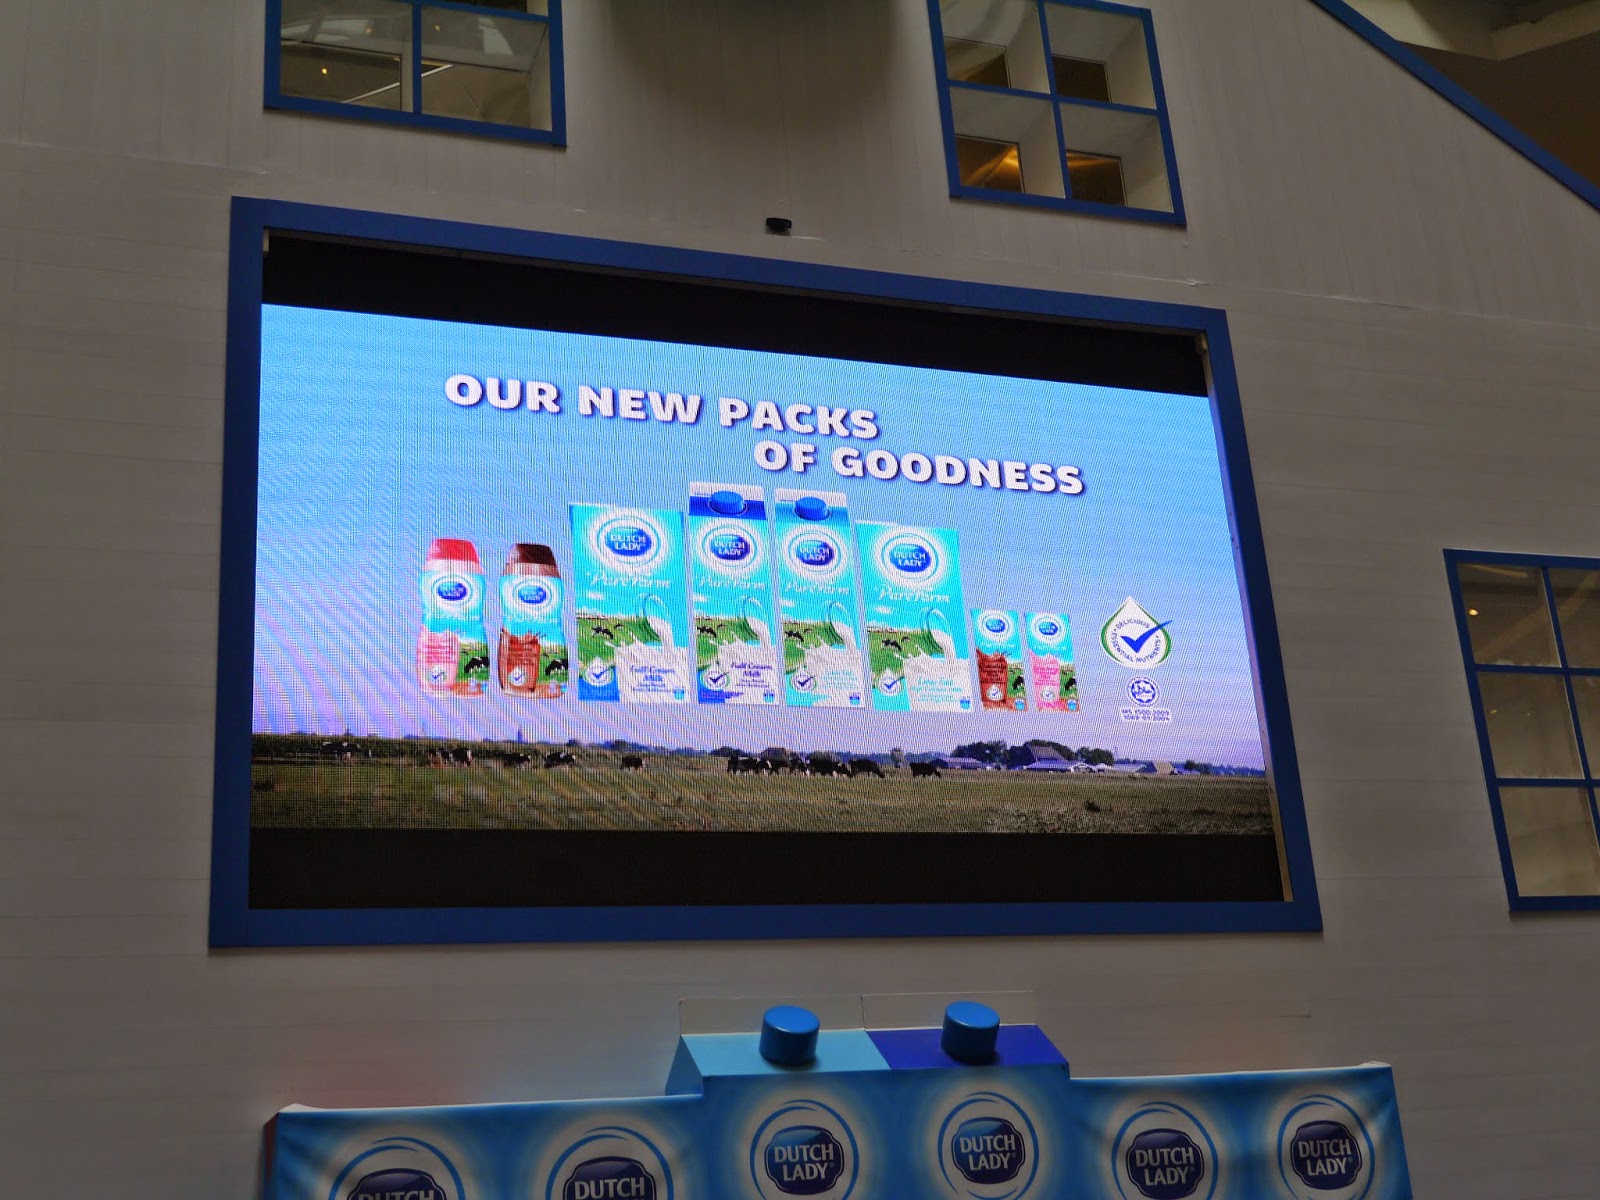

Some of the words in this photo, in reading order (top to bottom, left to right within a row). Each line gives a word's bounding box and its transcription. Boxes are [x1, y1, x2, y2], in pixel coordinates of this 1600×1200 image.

[445, 374, 560, 413] OUR
[578, 385, 701, 424] NEW
[718, 397, 879, 440] PACKS
[753, 440, 816, 473] OF
[831, 447, 1084, 495] GOODNESS
[611, 531, 647, 543] DUTCH
[714, 540, 746, 550] DUTCH
[800, 546, 830, 555] DUTCH
[893, 551, 926, 560] DUTCH
[774, 1143, 834, 1163] DUTCH
[960, 1134, 1016, 1153] DUTCH
[1297, 1138, 1352, 1158] DUTCH
[1135, 1147, 1195, 1168] DUTCH
[574, 1177, 645, 1200] DUTCH
